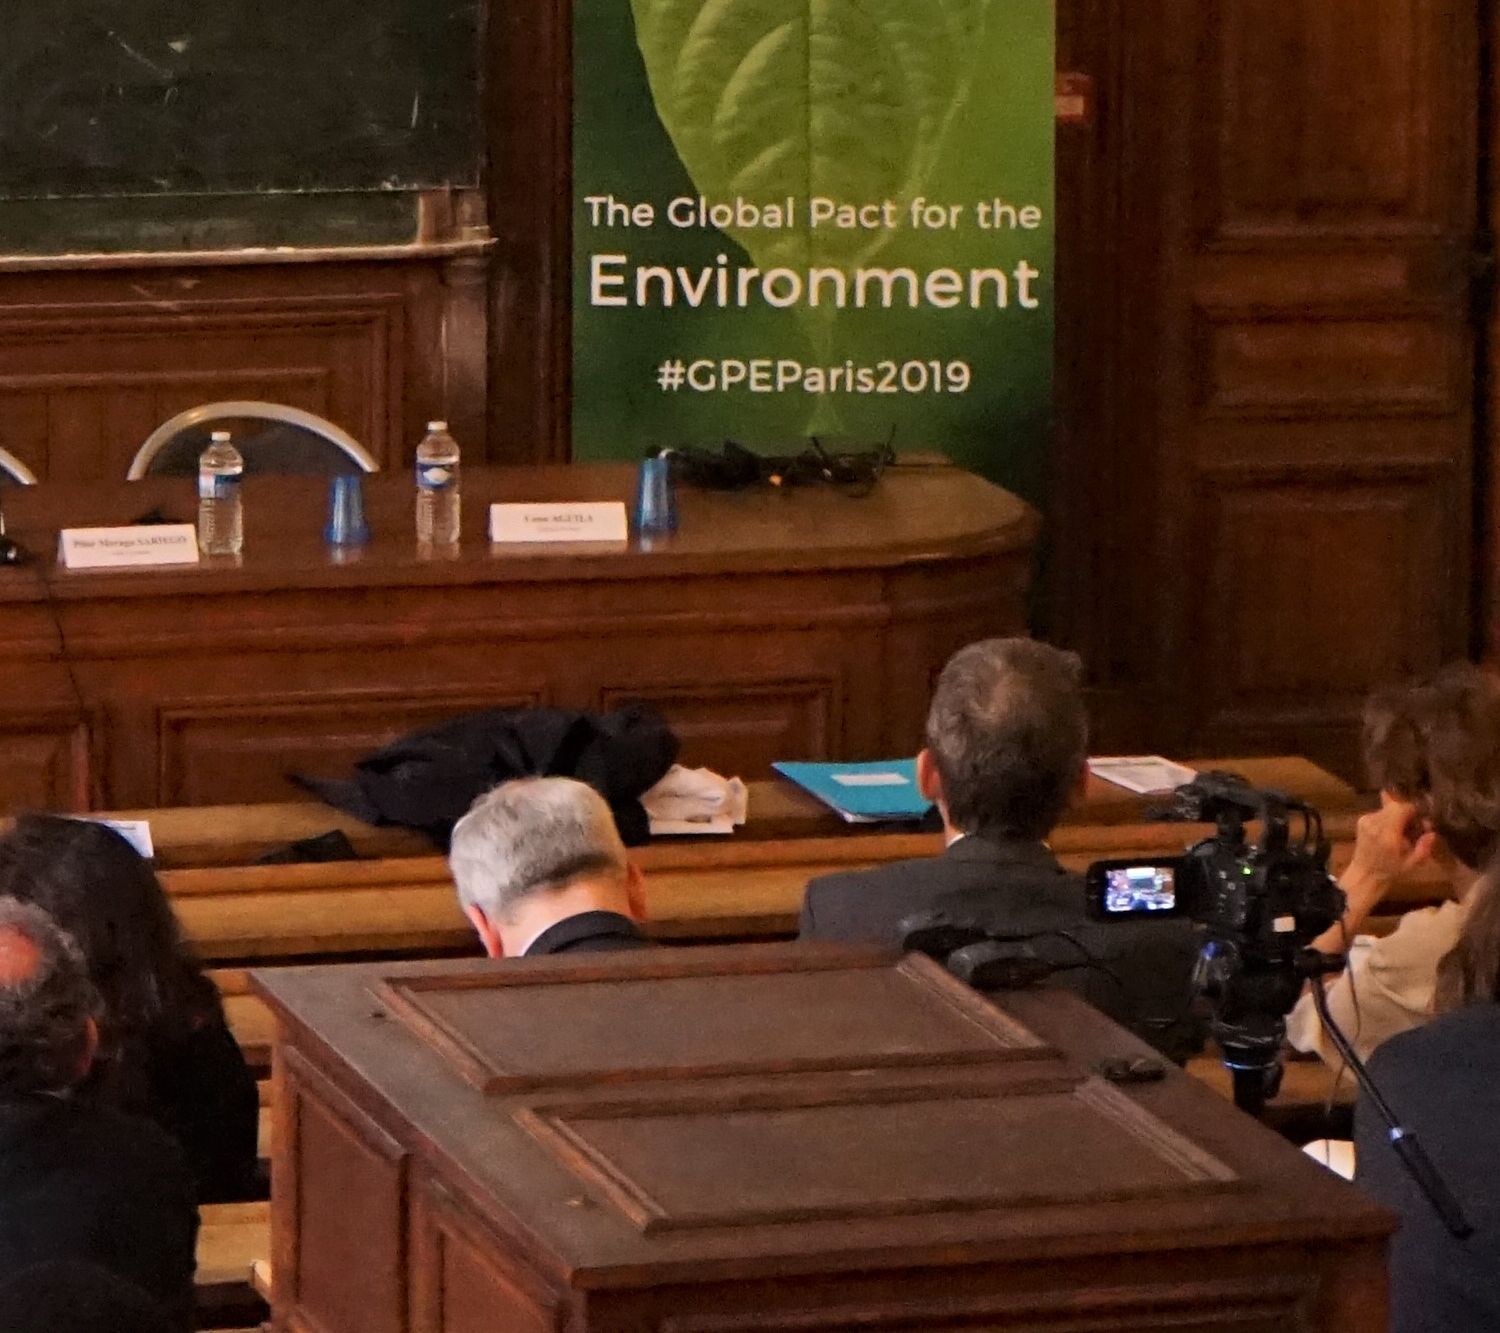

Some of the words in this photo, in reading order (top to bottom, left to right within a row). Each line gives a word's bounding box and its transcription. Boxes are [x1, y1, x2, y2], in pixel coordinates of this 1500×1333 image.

[585, 196, 655, 229] The
[667, 196, 795, 230] Global
[810, 197, 897, 230] Pact
[910, 196, 963, 229] for
[976, 198, 1042, 230] the
[590, 253, 1040, 309] Environment
[656, 358, 971, 394] #GPEParis2019
